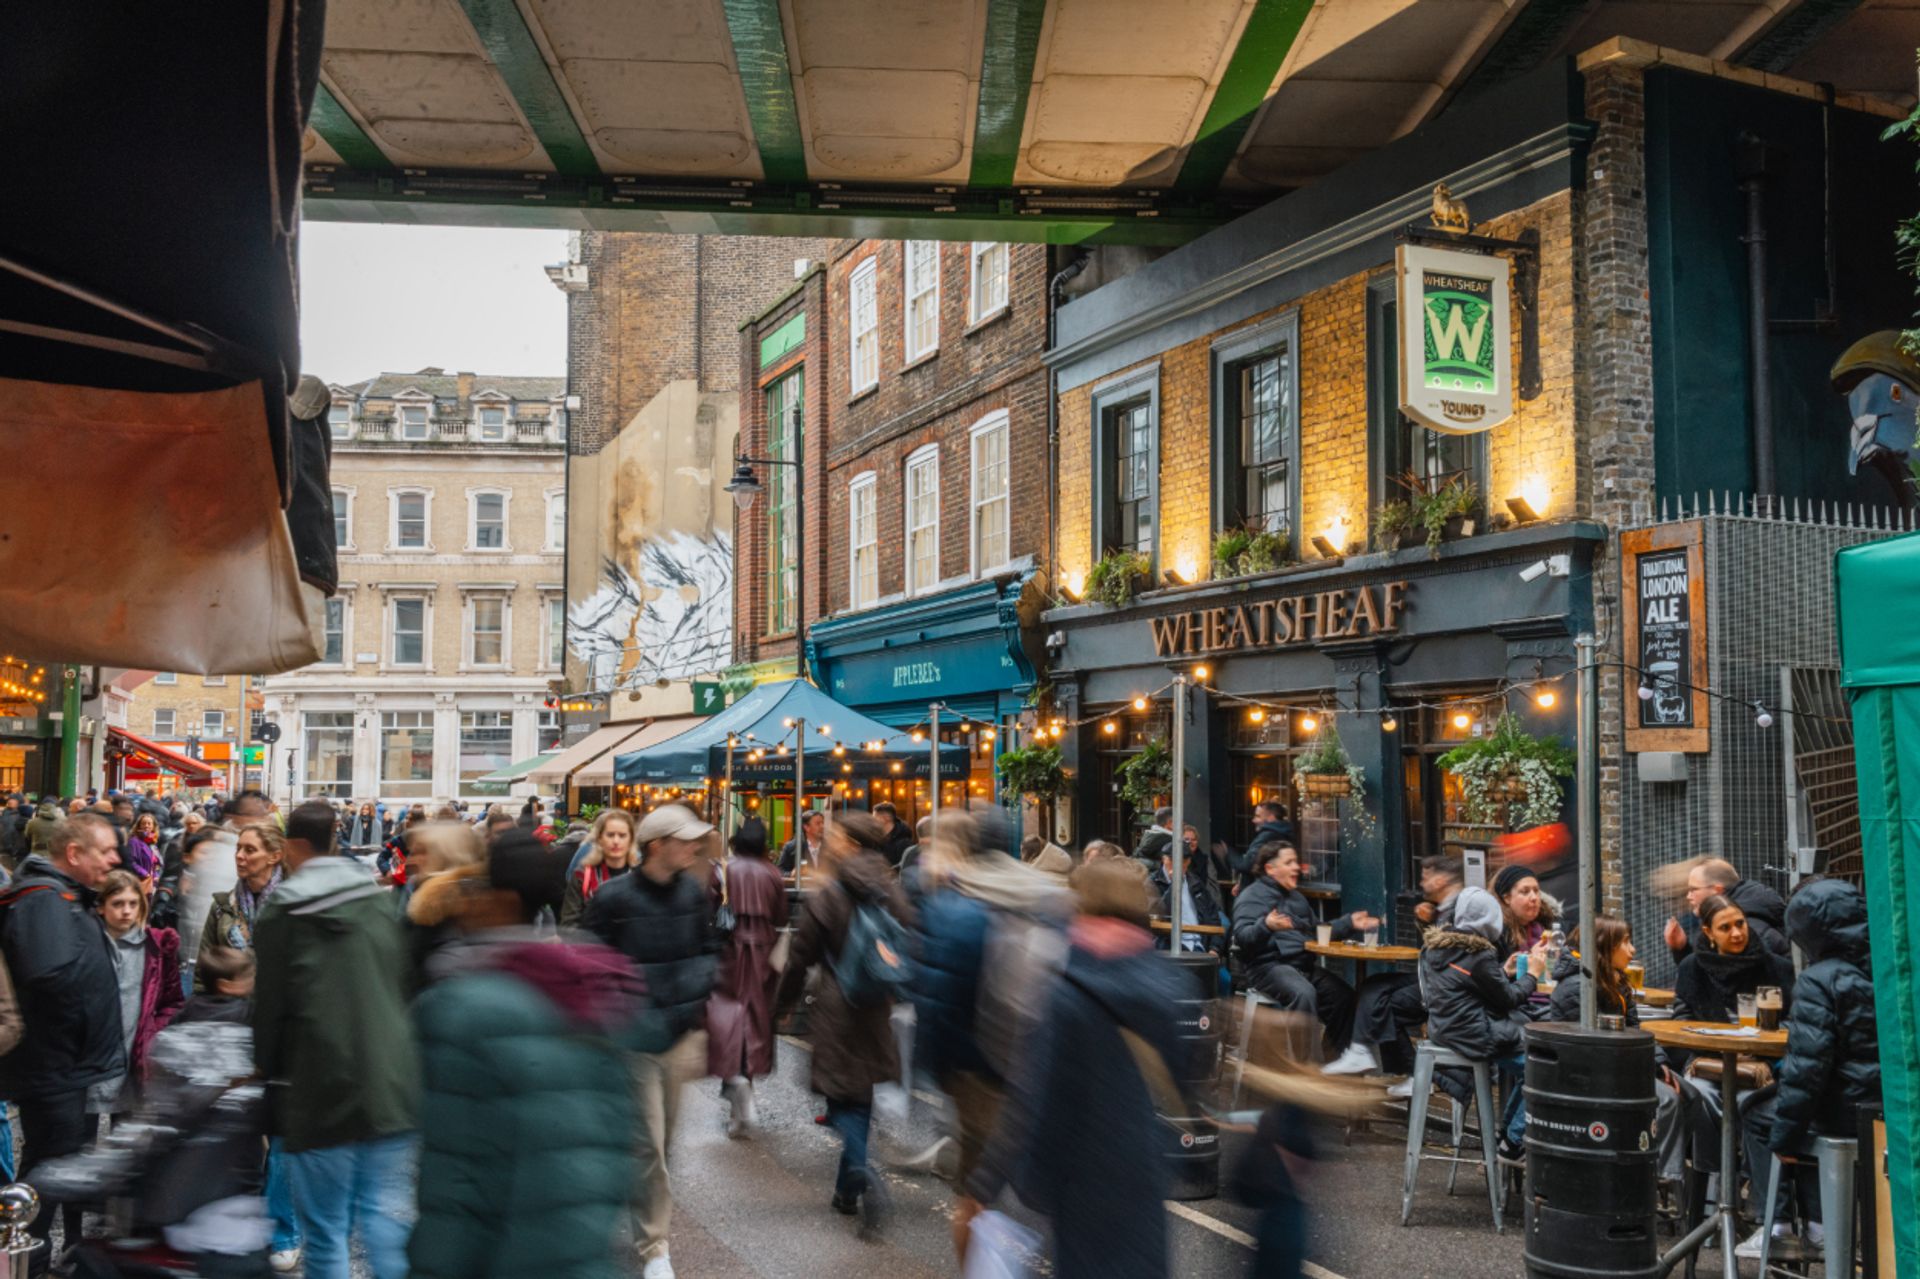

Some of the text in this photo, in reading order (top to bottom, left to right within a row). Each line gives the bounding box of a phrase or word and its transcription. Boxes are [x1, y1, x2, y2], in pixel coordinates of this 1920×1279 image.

[1424, 275, 1488, 293] WHEATSHEAF
[1643, 575, 1687, 598] LONDON
[1147, 580, 1408, 656] WHEATSHEAF
[1645, 598, 1679, 624] ALE
